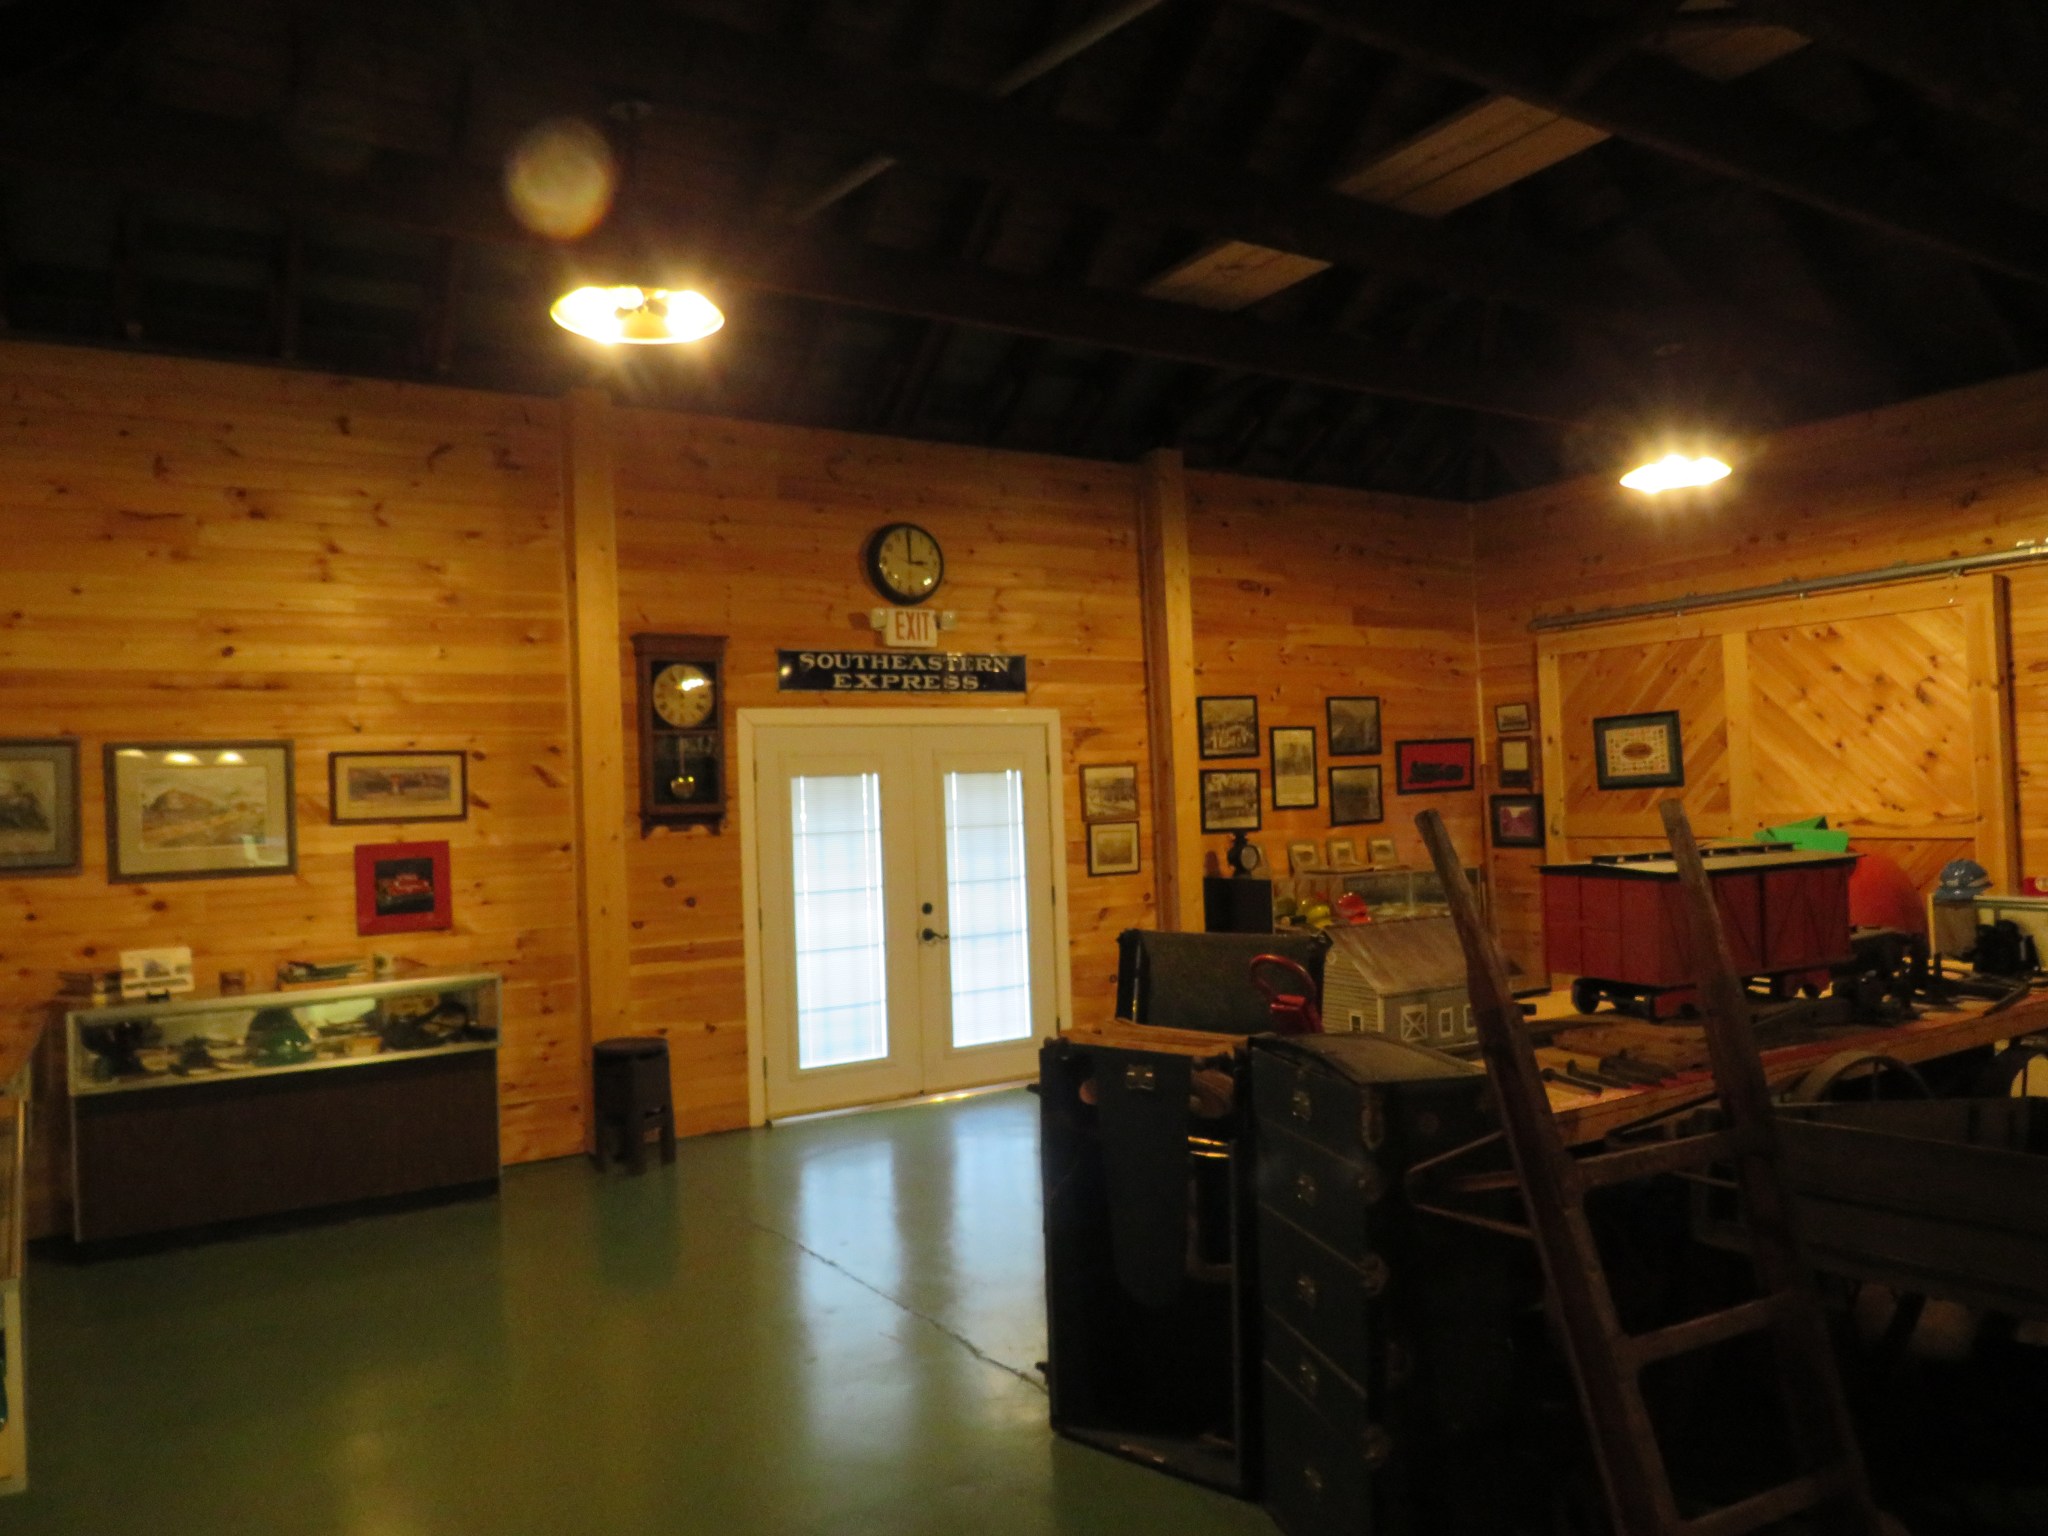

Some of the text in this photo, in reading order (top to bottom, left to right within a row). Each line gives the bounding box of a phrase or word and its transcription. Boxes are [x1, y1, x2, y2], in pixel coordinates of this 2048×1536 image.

[895, 611, 930, 641] EXIT
[799, 652, 1010, 673] SOUTHEASTERN
[833, 673, 980, 690] EXPRESS
